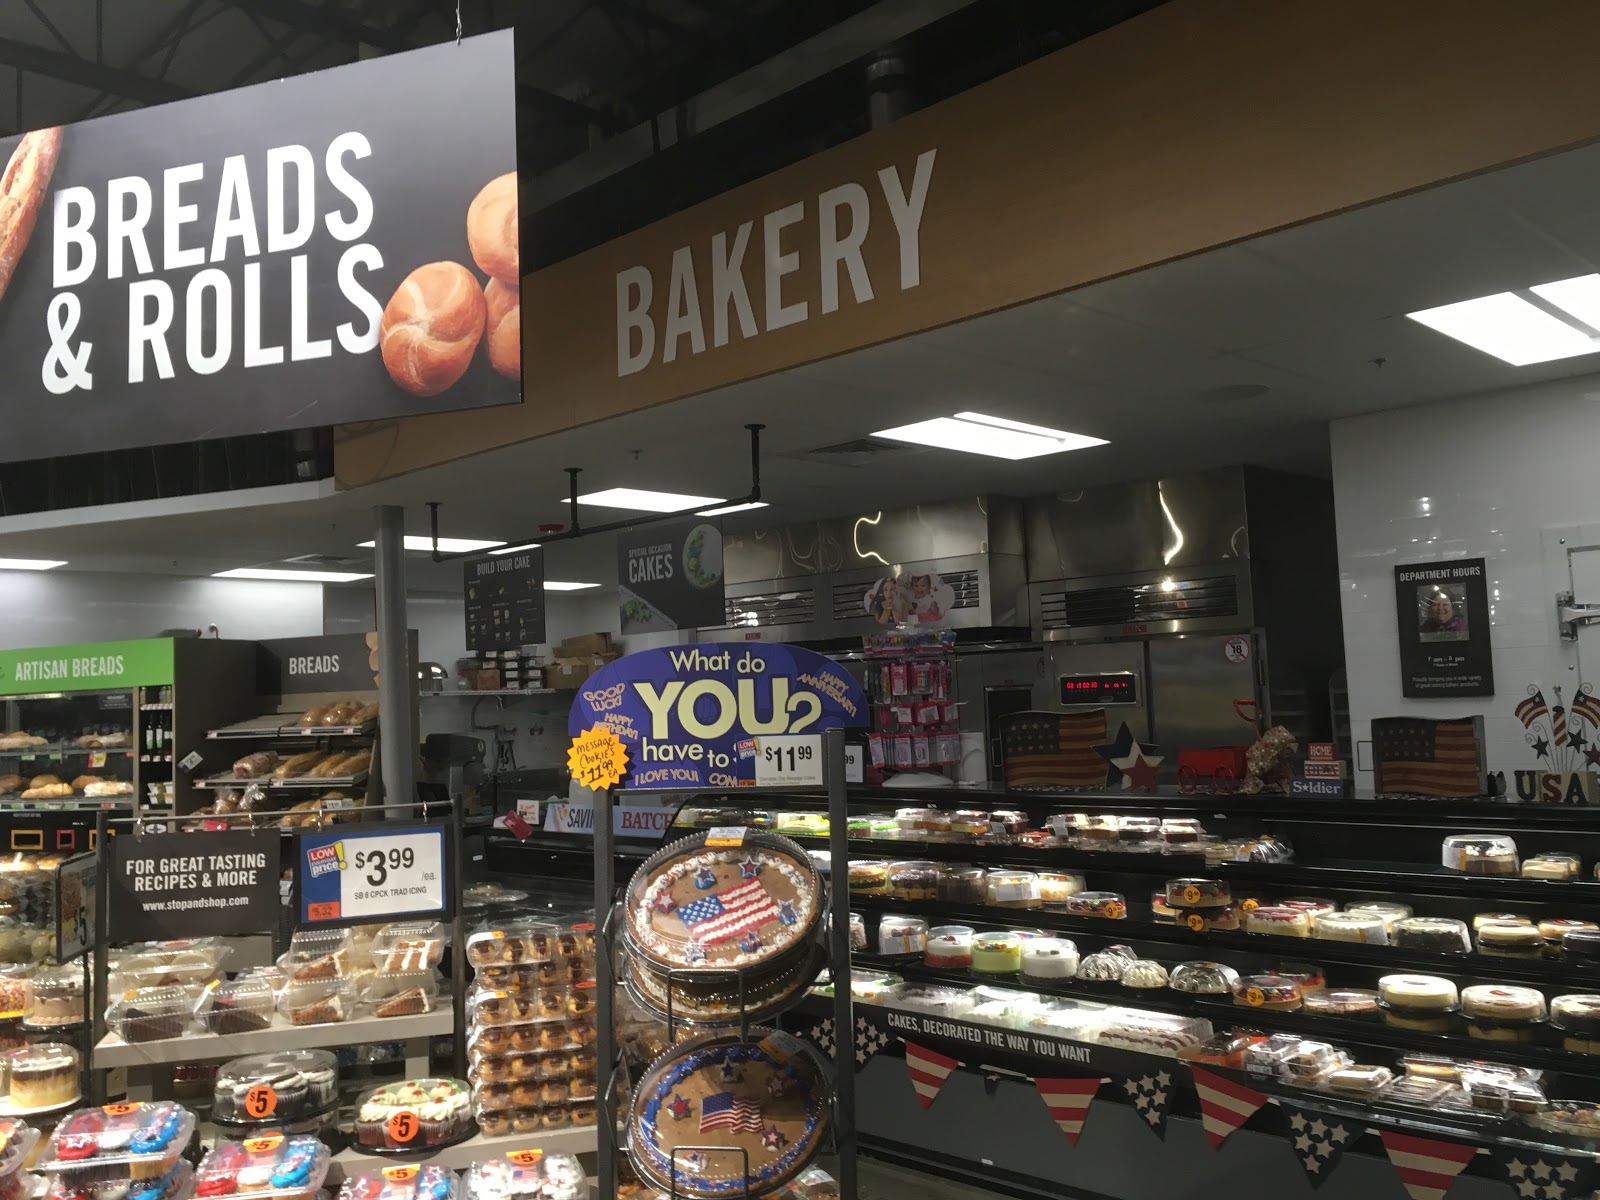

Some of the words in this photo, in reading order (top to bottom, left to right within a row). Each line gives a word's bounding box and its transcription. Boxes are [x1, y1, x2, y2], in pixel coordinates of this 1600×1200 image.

[53, 131, 374, 288] BREADS
[616, 148, 937, 377] BAKERY
[41, 291, 93, 394] &
[128, 243, 385, 383] ROLLS
[628, 547, 647, 558] SPECIAL
[476, 562, 495, 576] BUILD
[496, 558, 513, 572] YOUR
[514, 555, 531, 570] CAKE
[628, 553, 673, 584] CAKES
[1400, 569, 1450, 582] DEPARTMENT
[1453, 566, 1481, 578] HOURS
[15, 658, 68, 681] ARTISAN
[72, 655, 124, 677] BREADS
[289, 655, 340, 675] BREADS
[669, 648, 730, 672] What
[736, 651, 766, 674] do
[583, 683, 626, 701] GOOD
[633, 677, 822, 739] YOU?
[642, 737, 704, 762] have
[707, 749, 729, 768] to
[640, 769, 669, 784] LOVE
[1515, 770, 1590, 804] USA
[567, 808, 594, 828] SAVI
[126, 859, 155, 875] FOR
[160, 857, 204, 873] GREAT
[208, 853, 266, 870] TASTING
[310, 846, 335, 861] LOW
[135, 874, 197, 891] RECIPES
[201, 872, 212, 887] &
[217, 870, 257, 886] MORE
[142, 896, 249, 911] www.stopandshop.com
[354, 892, 363, 900] SB
[370, 889, 389, 898] CPCK
[390, 888, 408, 896] TRAD
[409, 886, 427, 895] ICING
[887, 1012, 921, 1034] CAKES,
[923, 1019, 981, 1043] DECORATED
[984, 1030, 1005, 1048] THE
[1006, 1034, 1029, 1052] WAY
[1031, 1038, 1055, 1057] YOU
[1057, 1044, 1092, 1064] WANT
[249, 1090, 268, 1113] $5
[393, 1115, 411, 1138] $5
